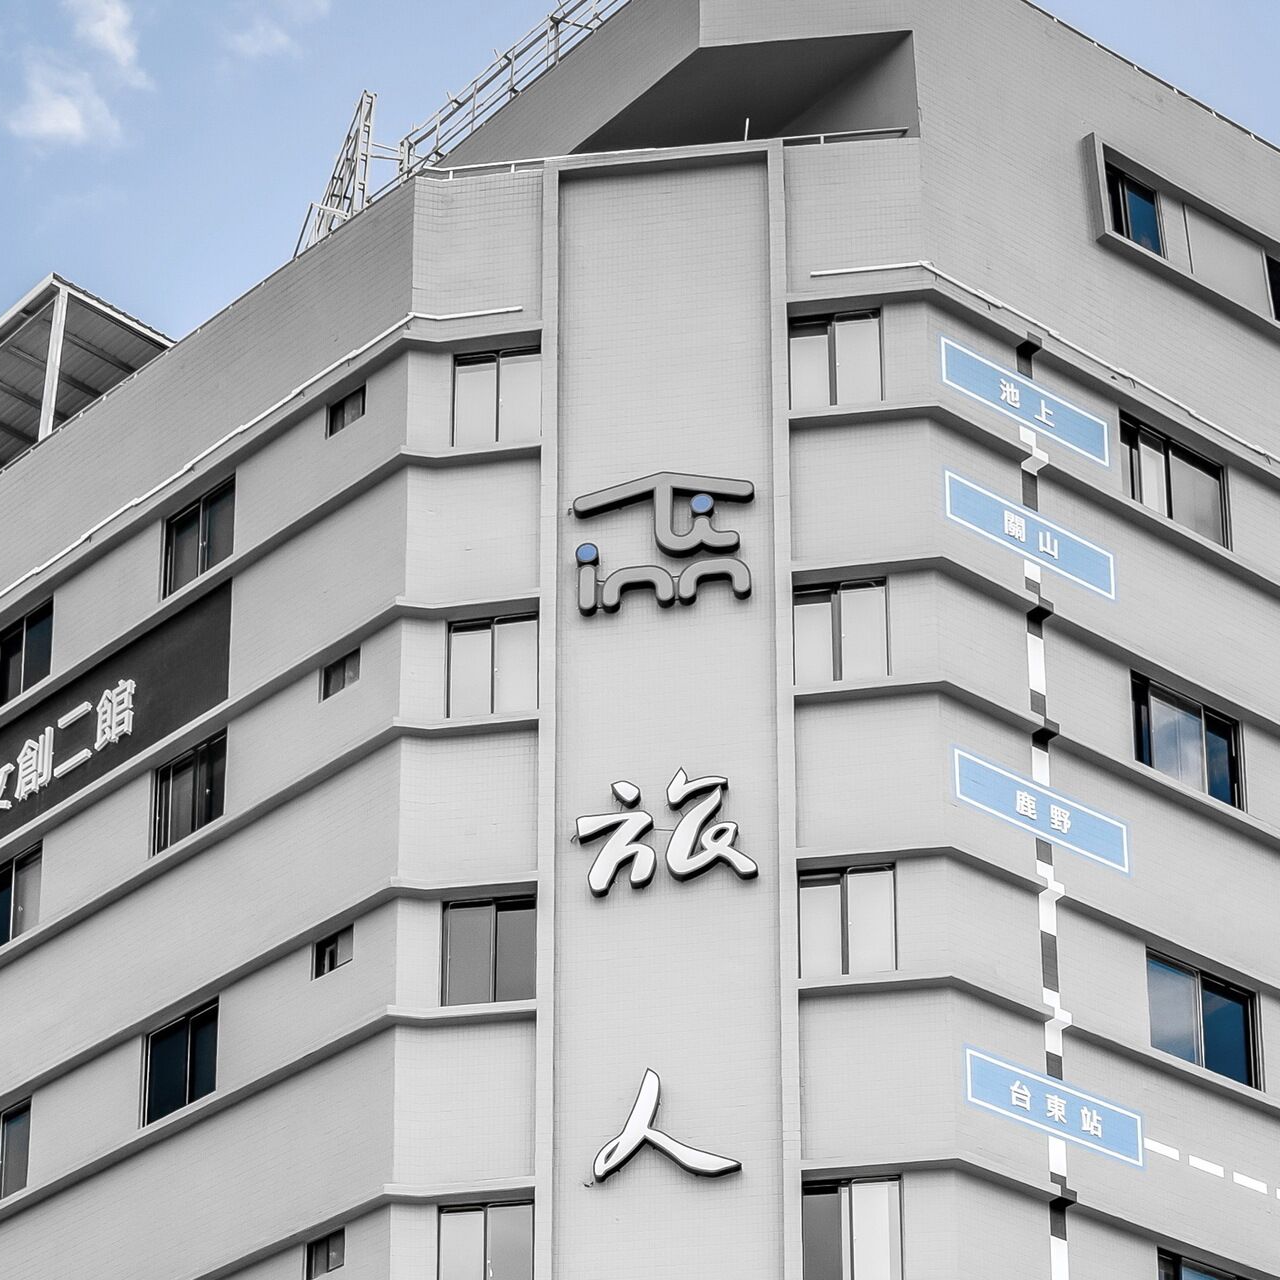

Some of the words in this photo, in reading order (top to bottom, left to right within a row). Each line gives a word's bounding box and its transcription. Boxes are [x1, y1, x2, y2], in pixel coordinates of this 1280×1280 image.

[1000, 379, 1056, 428] 池上
[1004, 510, 1059, 560] 關山
[1016, 790, 1071, 834] 鹿野
[1010, 1080, 1103, 1138] 台東站
